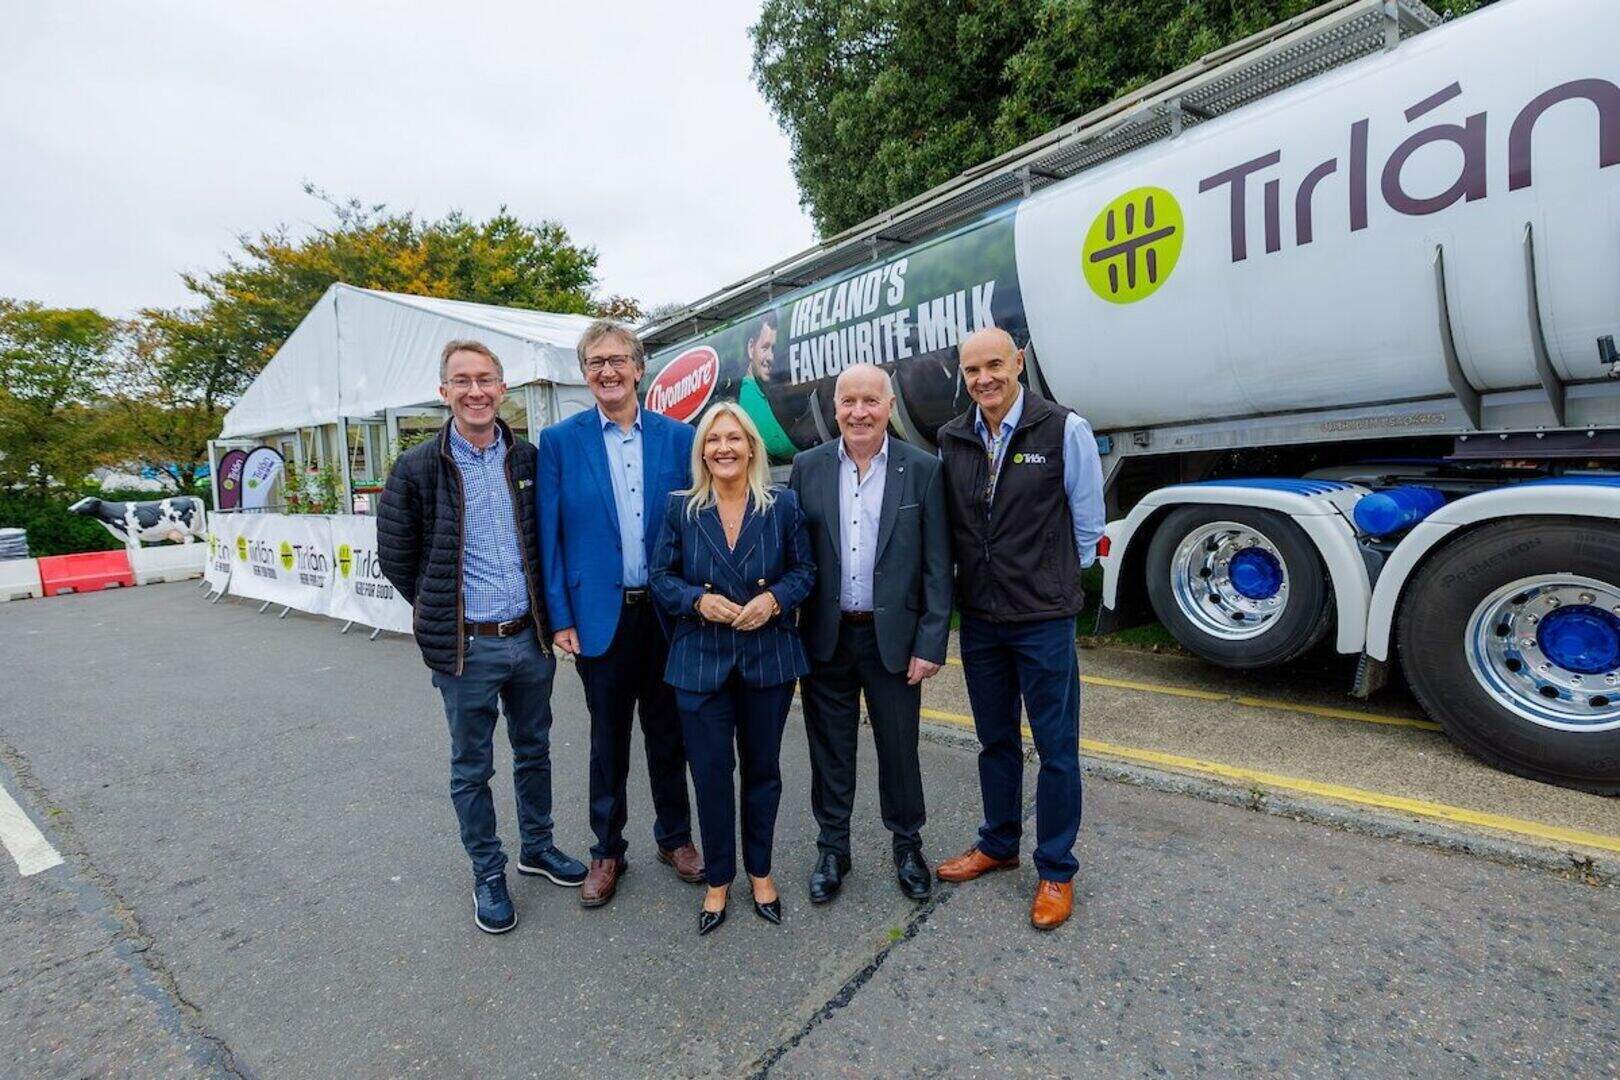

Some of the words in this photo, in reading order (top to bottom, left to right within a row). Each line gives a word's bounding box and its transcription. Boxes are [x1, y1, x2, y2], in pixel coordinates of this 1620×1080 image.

[1199, 80, 1620, 263] Tirlán
[789, 308, 913, 386] FAVOURITE
[917, 280, 996, 355] MILK
[790, 258, 908, 339] IRELAND'S
[353, 549, 385, 580] Tirlá
